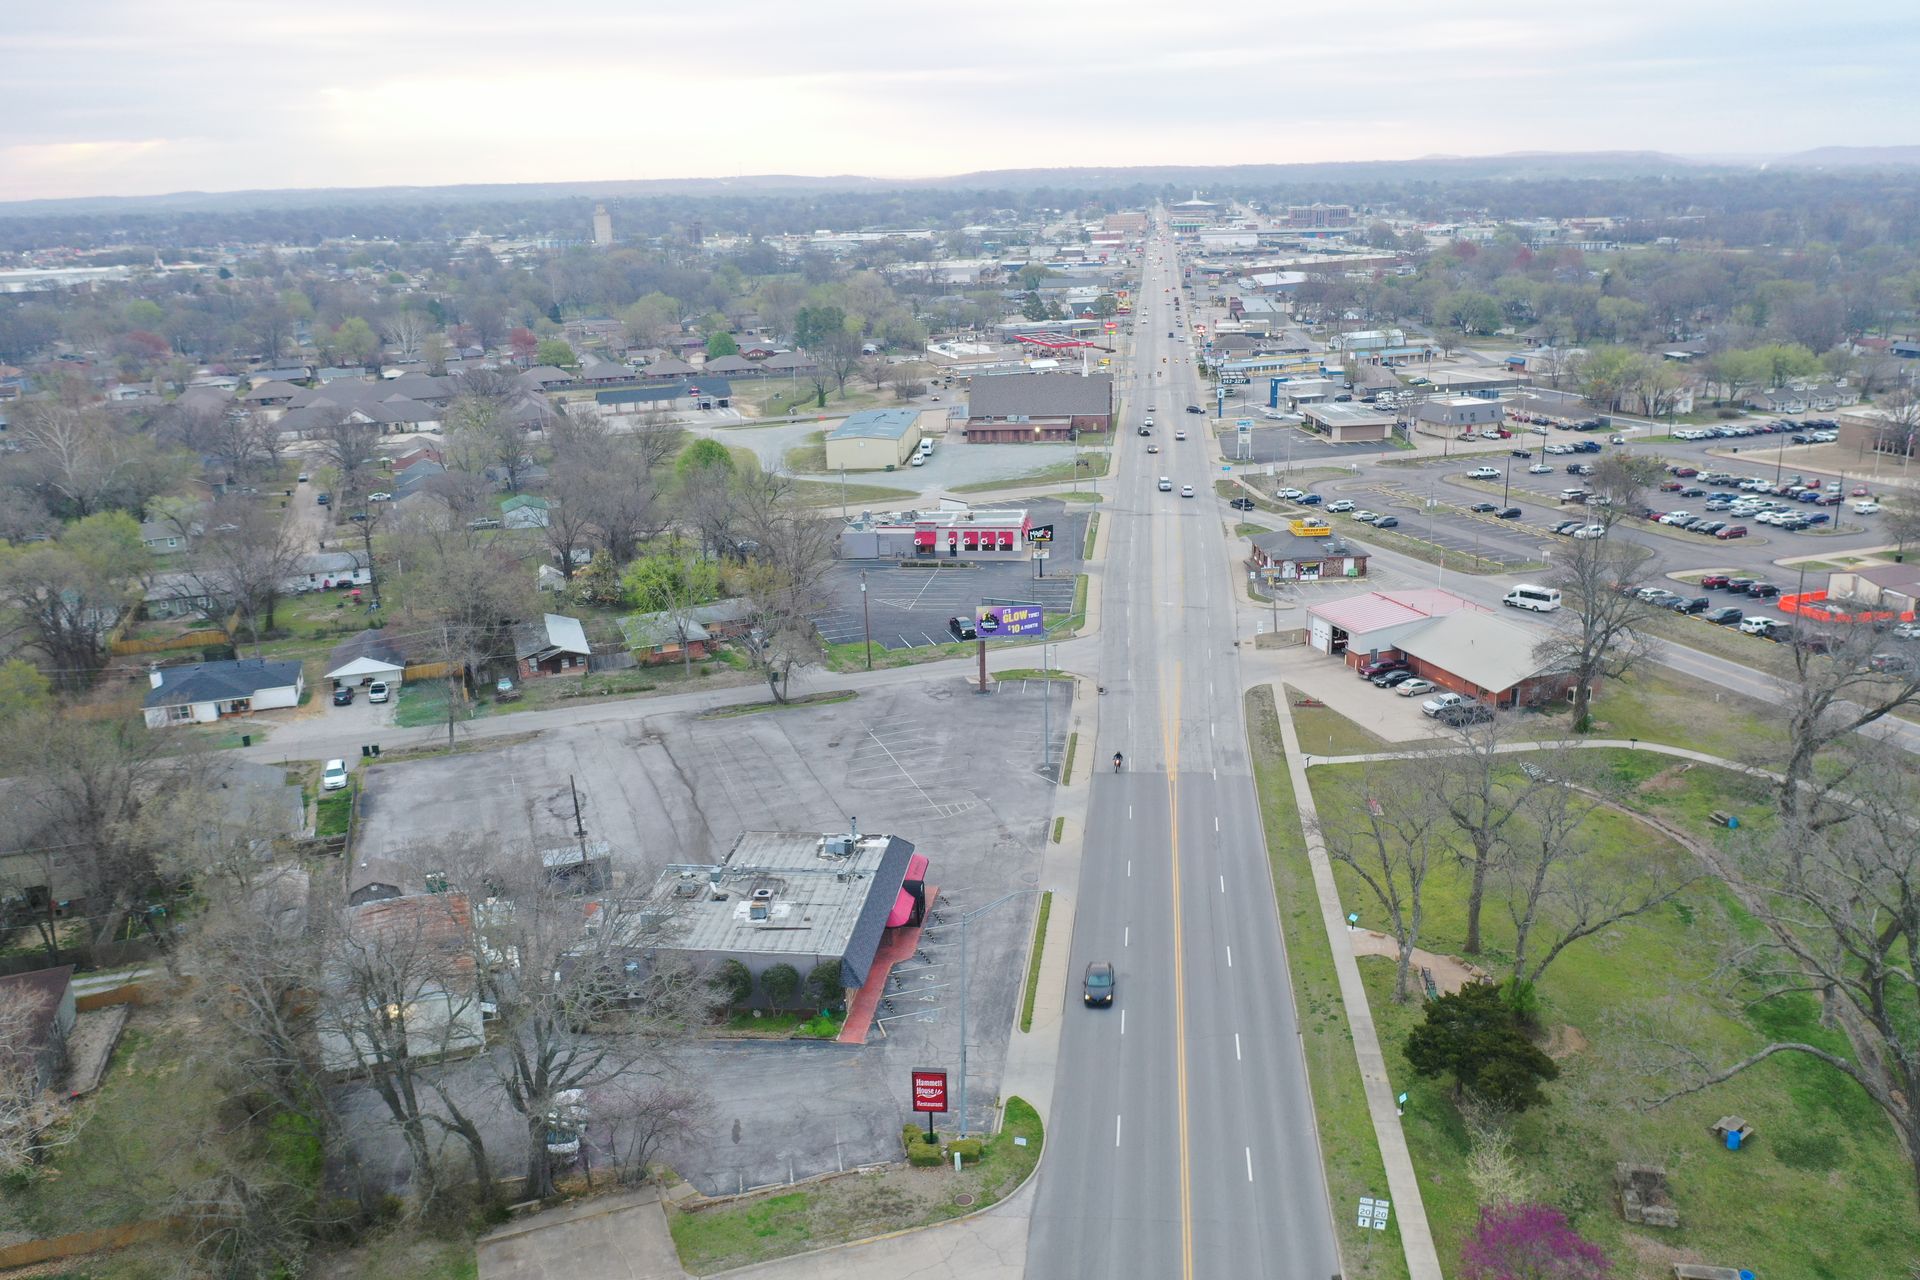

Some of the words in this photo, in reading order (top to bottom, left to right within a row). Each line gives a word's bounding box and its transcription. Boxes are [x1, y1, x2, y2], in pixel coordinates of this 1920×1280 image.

[1003, 610, 1028, 623] GLOW
[1007, 624, 1020, 633] $10
[1024, 622, 1039, 630] MONTH
[916, 1087, 935, 1095] House
[1359, 1208, 1371, 1216] 20
[1375, 1210, 1387, 1218] 20
